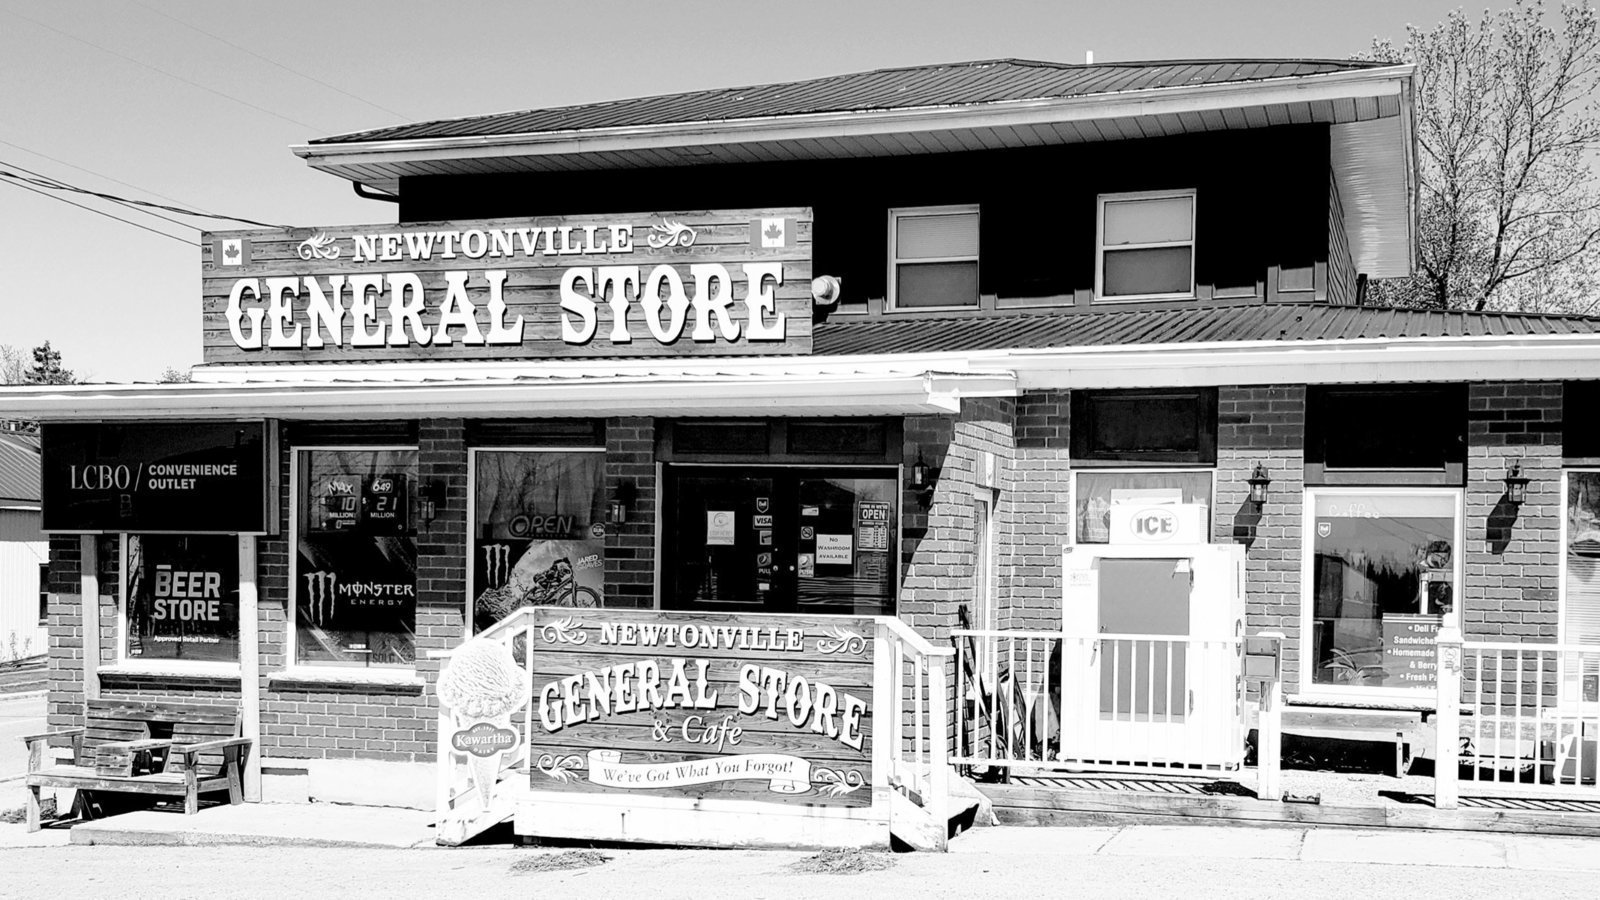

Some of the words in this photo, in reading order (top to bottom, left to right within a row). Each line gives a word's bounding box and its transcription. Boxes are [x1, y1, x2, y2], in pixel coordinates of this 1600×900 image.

[352, 224, 634, 262] NEWTONVILLE
[224, 269, 524, 350] GENERAL
[559, 262, 786, 345] STORE
[70, 464, 130, 489] LCBO
[148, 464, 237, 476] CONVENIENCE
[148, 478, 196, 490] OUTLET
[328, 480, 353, 495] MAX
[372, 480, 391, 492] 649
[756, 517, 772, 525] VISA
[862, 509, 886, 520] OPEN
[509, 515, 573, 537] OPEN
[1136, 516, 1172, 536] ICE
[577, 555, 599, 563] JARED
[155, 564, 220, 598] BEER
[153, 599, 220, 621] STORE
[599, 621, 804, 651] NEWTONVILLE
[1414, 624, 1429, 633] Deli
[154, 635, 182, 643] Approved
[1392, 648, 1435, 657] Homemade
[1409, 661, 1416, 669] &
[1406, 673, 1427, 681] Fresh
[538, 657, 719, 734] GENERAL
[738, 663, 867, 751] STORE
[456, 733, 513, 747] Kawartha
[652, 719, 673, 742] &
[682, 715, 743, 752] Cafe
[603, 768, 642, 783] We've
[646, 768, 671, 782] Got
[675, 763, 709, 780] What
[714, 760, 740, 775] You
[745, 759, 793, 775] Forgot!
